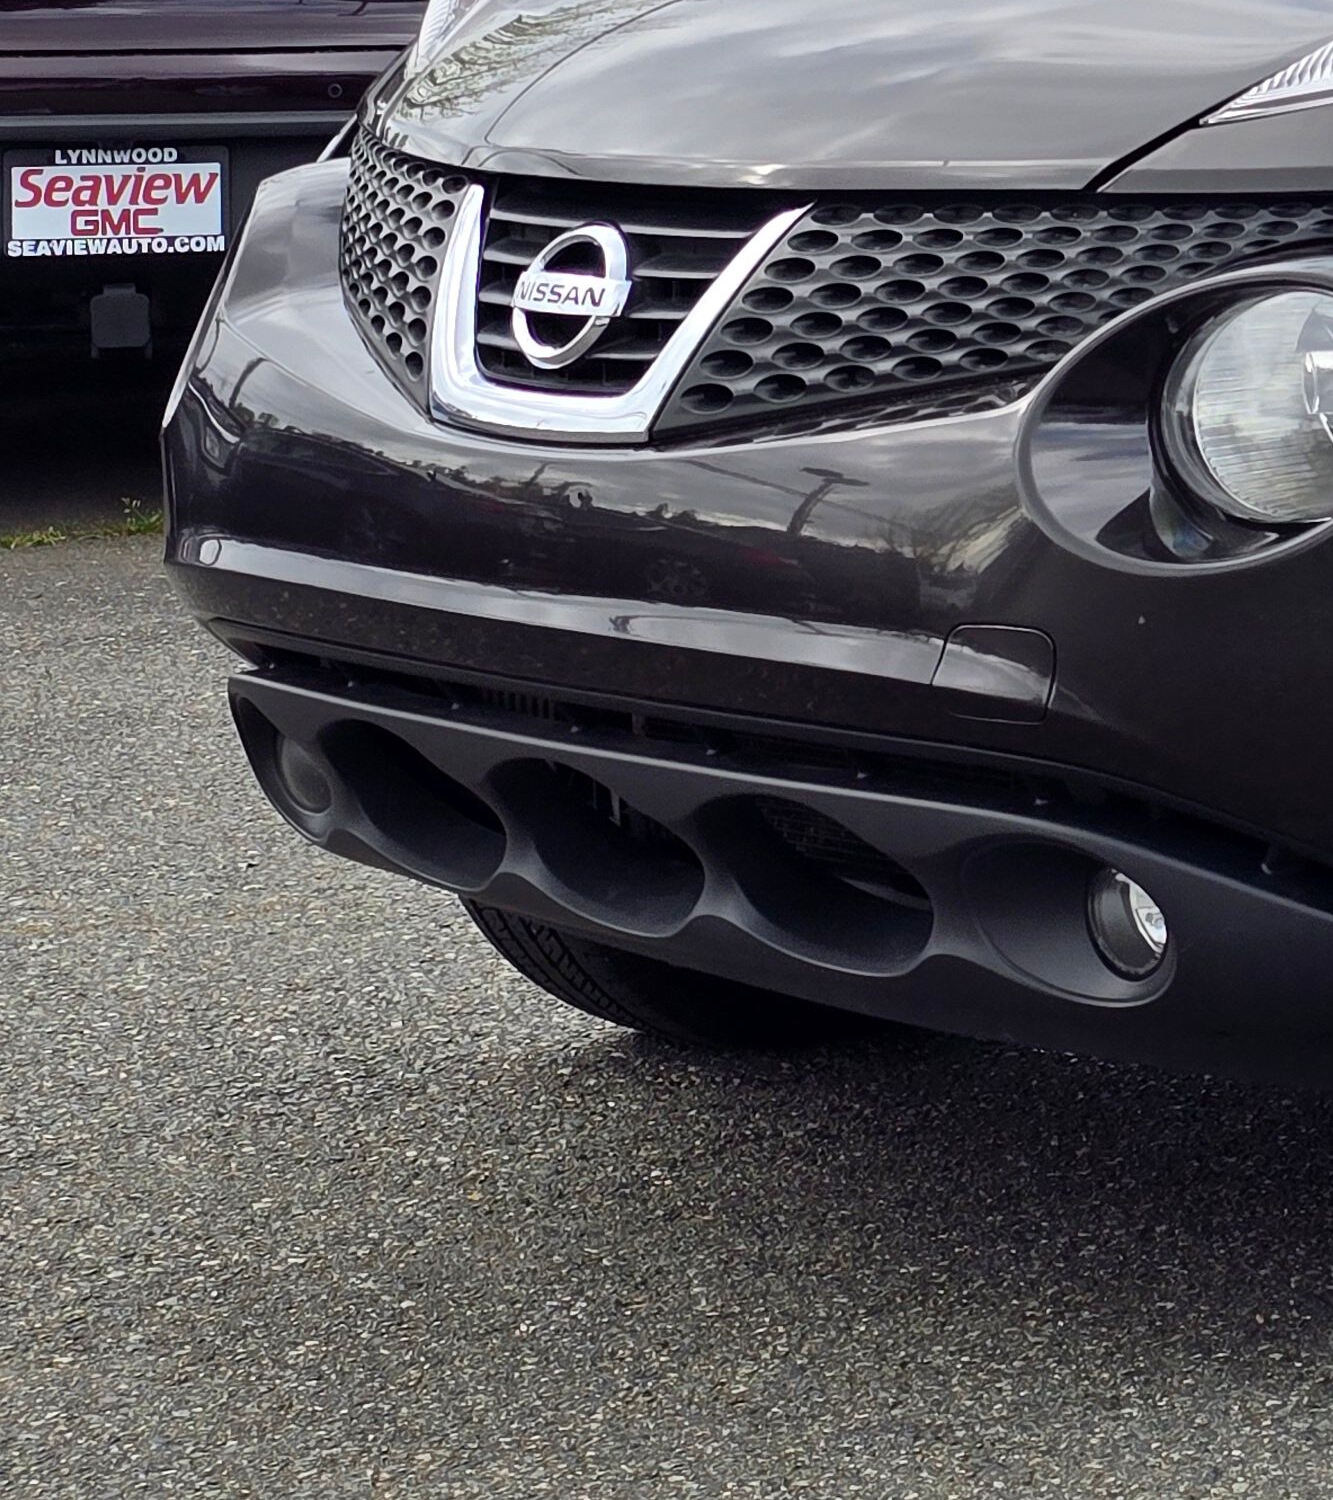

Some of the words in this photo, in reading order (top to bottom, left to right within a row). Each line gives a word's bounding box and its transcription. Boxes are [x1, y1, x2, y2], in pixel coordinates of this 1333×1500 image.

[55, 148, 178, 164] LYNNWOOD
[14, 167, 219, 208] Seaview
[70, 208, 164, 236] GMC
[7, 235, 225, 257] SEAVIEWAUTO.COM
[516, 280, 606, 308] NISSAN
